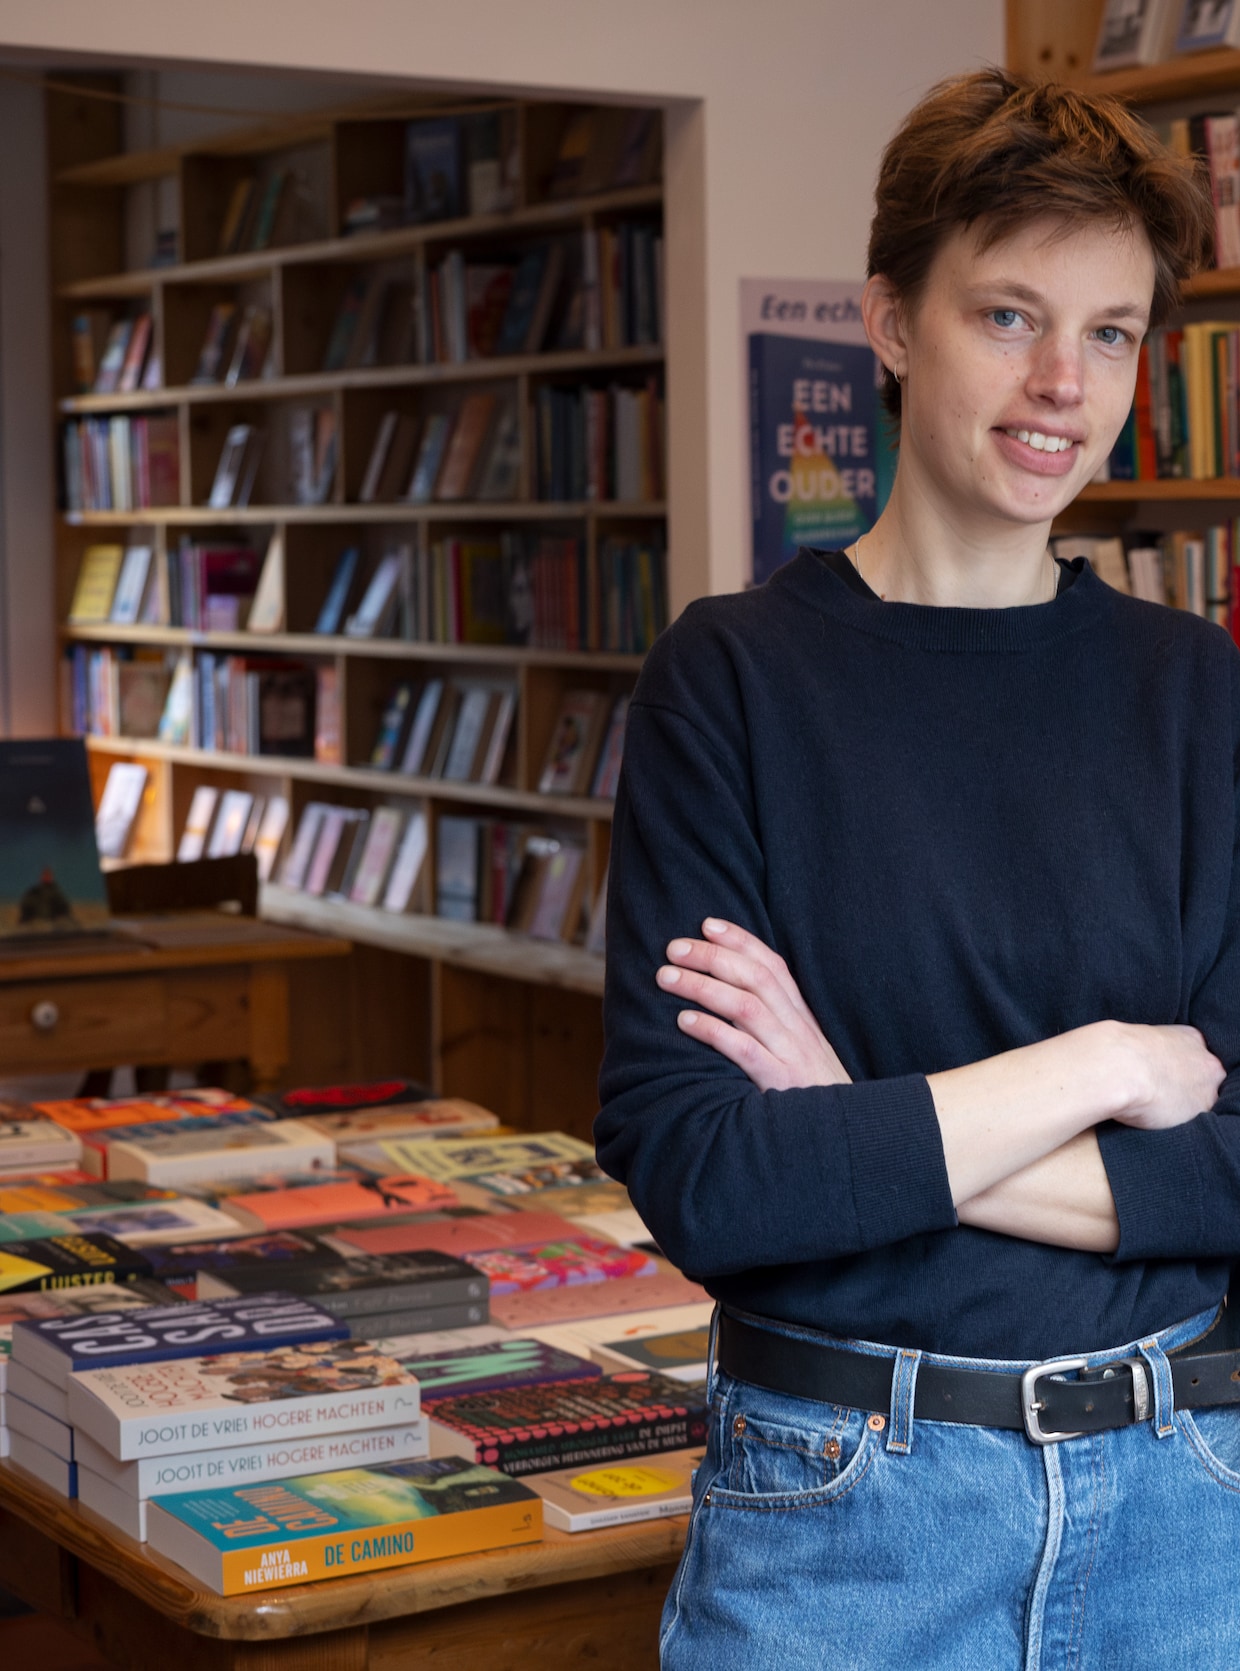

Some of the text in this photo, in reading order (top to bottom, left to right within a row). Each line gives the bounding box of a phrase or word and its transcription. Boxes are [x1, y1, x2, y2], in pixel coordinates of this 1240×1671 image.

[760, 294, 863, 323] Een ech
[792, 379, 852, 412] EEN
[776, 423, 868, 457] ECHTE
[769, 469, 875, 504] OUDER
[138, 1400, 385, 1446] JOOST DE VRIES HOGERE MACHTEN
[156, 1436, 395, 1485] JOOST DE VRIES HOGERE MACHTEN
[503, 1434, 688, 1474] VERBORGEN HERINNERING VAN DE MENS
[229, 1484, 344, 1532] CAMINO
[207, 1515, 283, 1538] DE
[260, 1549, 291, 1569] ANYA
[324, 1532, 415, 1567] DE CAMINO
[244, 1561, 308, 1585] NIEWIERRA
